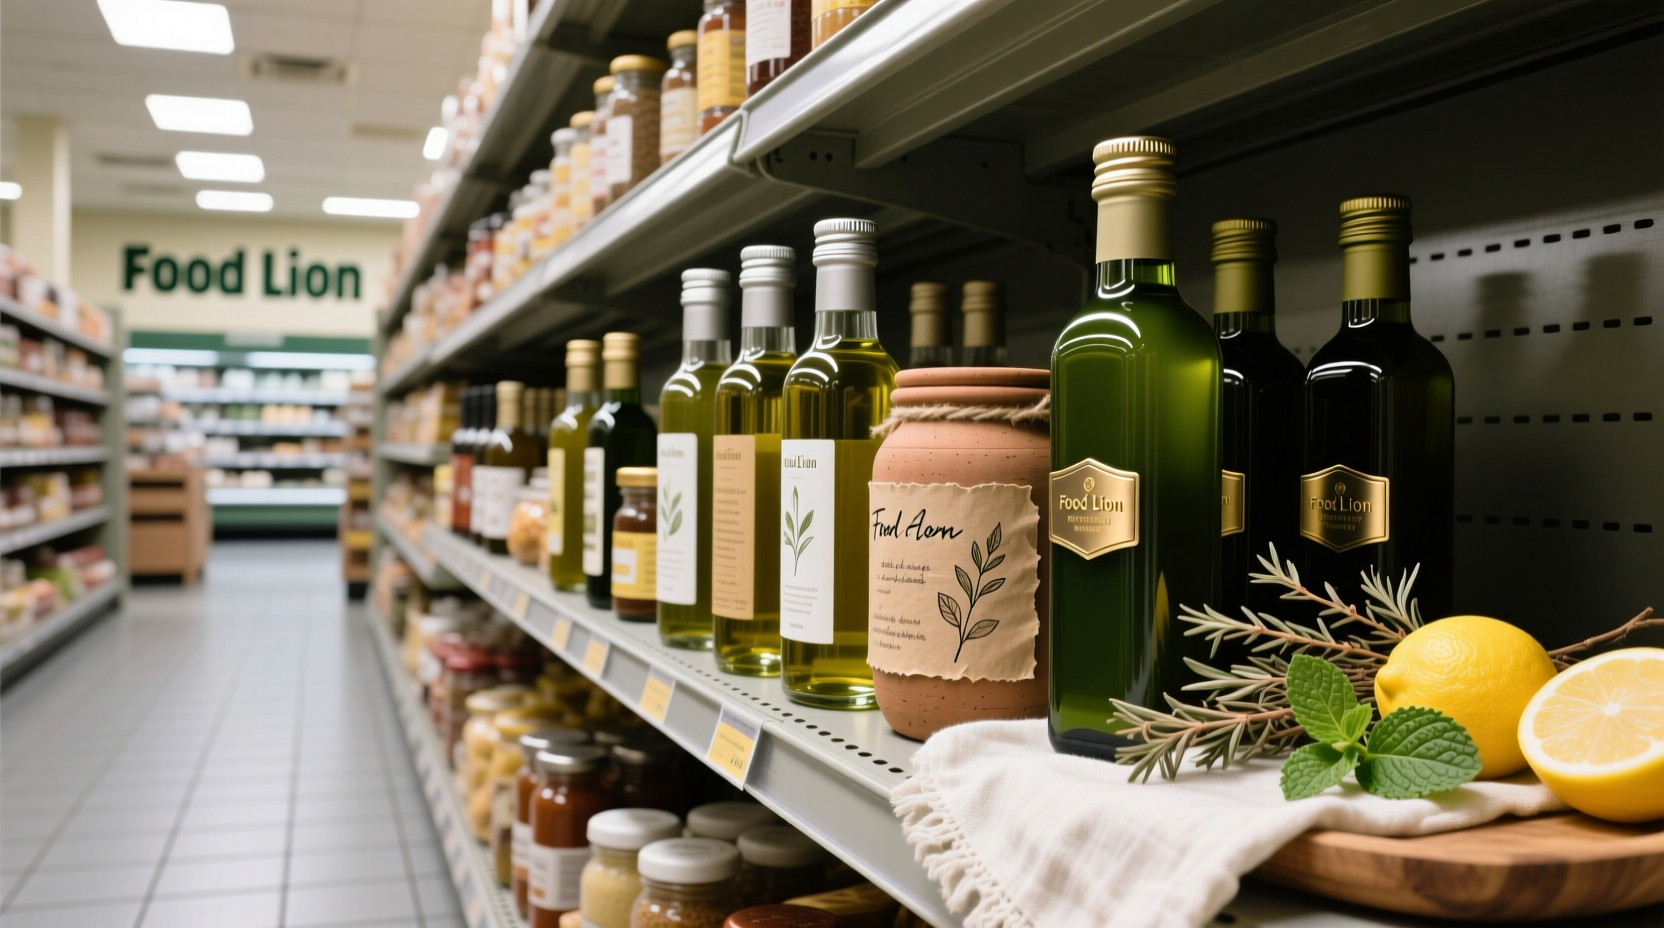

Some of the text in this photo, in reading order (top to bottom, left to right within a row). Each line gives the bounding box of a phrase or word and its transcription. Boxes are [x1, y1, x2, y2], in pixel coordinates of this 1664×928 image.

[123, 246, 360, 299] Food Lion
[1059, 494, 1123, 512] Food Lion
[1340, 495, 1372, 513] Lion
